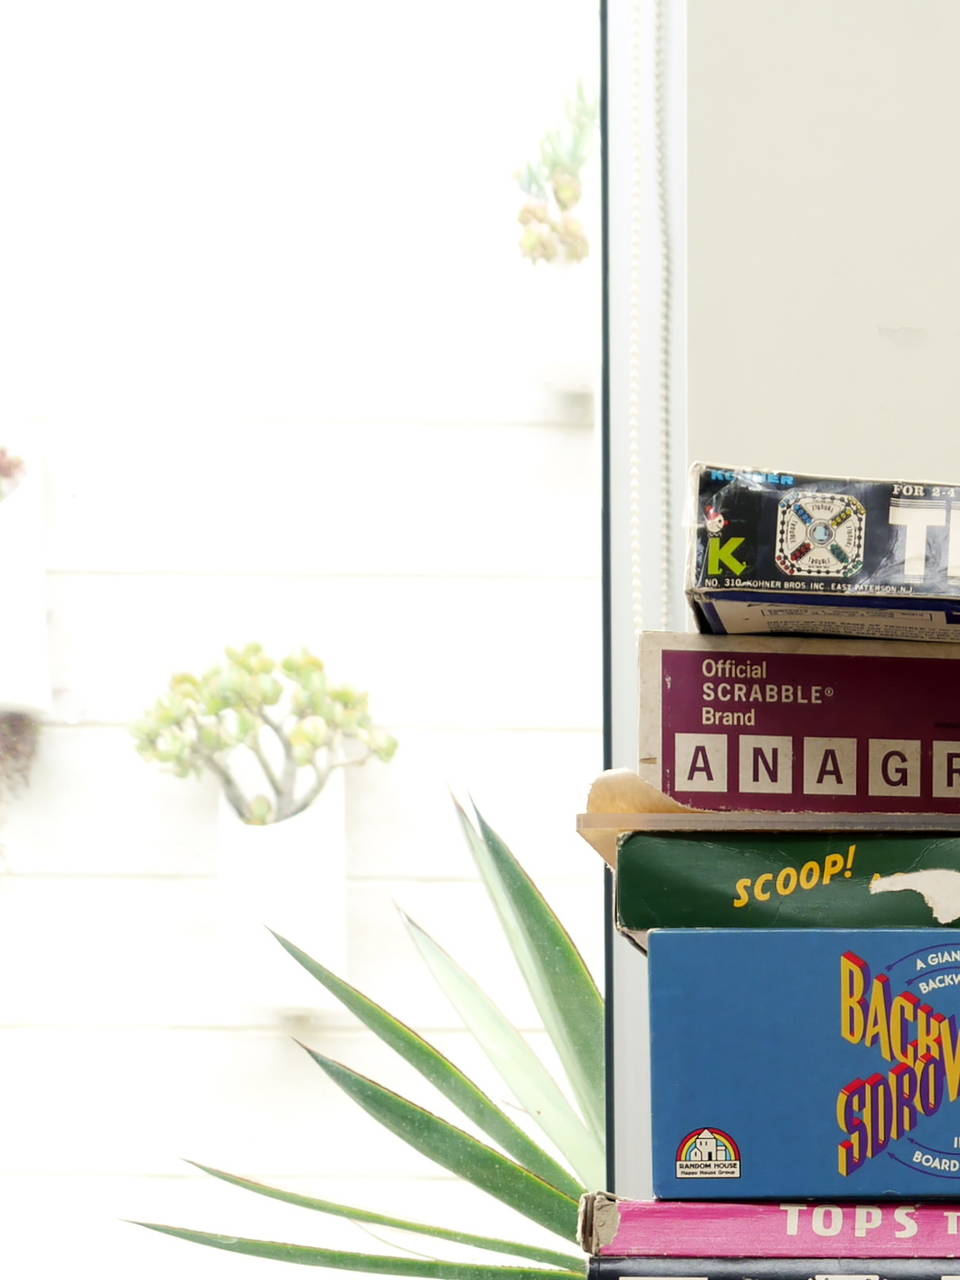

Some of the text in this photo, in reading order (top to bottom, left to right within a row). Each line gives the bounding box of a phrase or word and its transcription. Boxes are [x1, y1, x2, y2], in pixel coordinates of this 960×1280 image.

[707, 537, 746, 575] K
[702, 658, 767, 679] Official
[702, 707, 755, 726] Brand
[733, 844, 856, 908] SCOOP!
[913, 1151, 960, 1172] BOARD
[780, 1204, 919, 1239] TOPS
